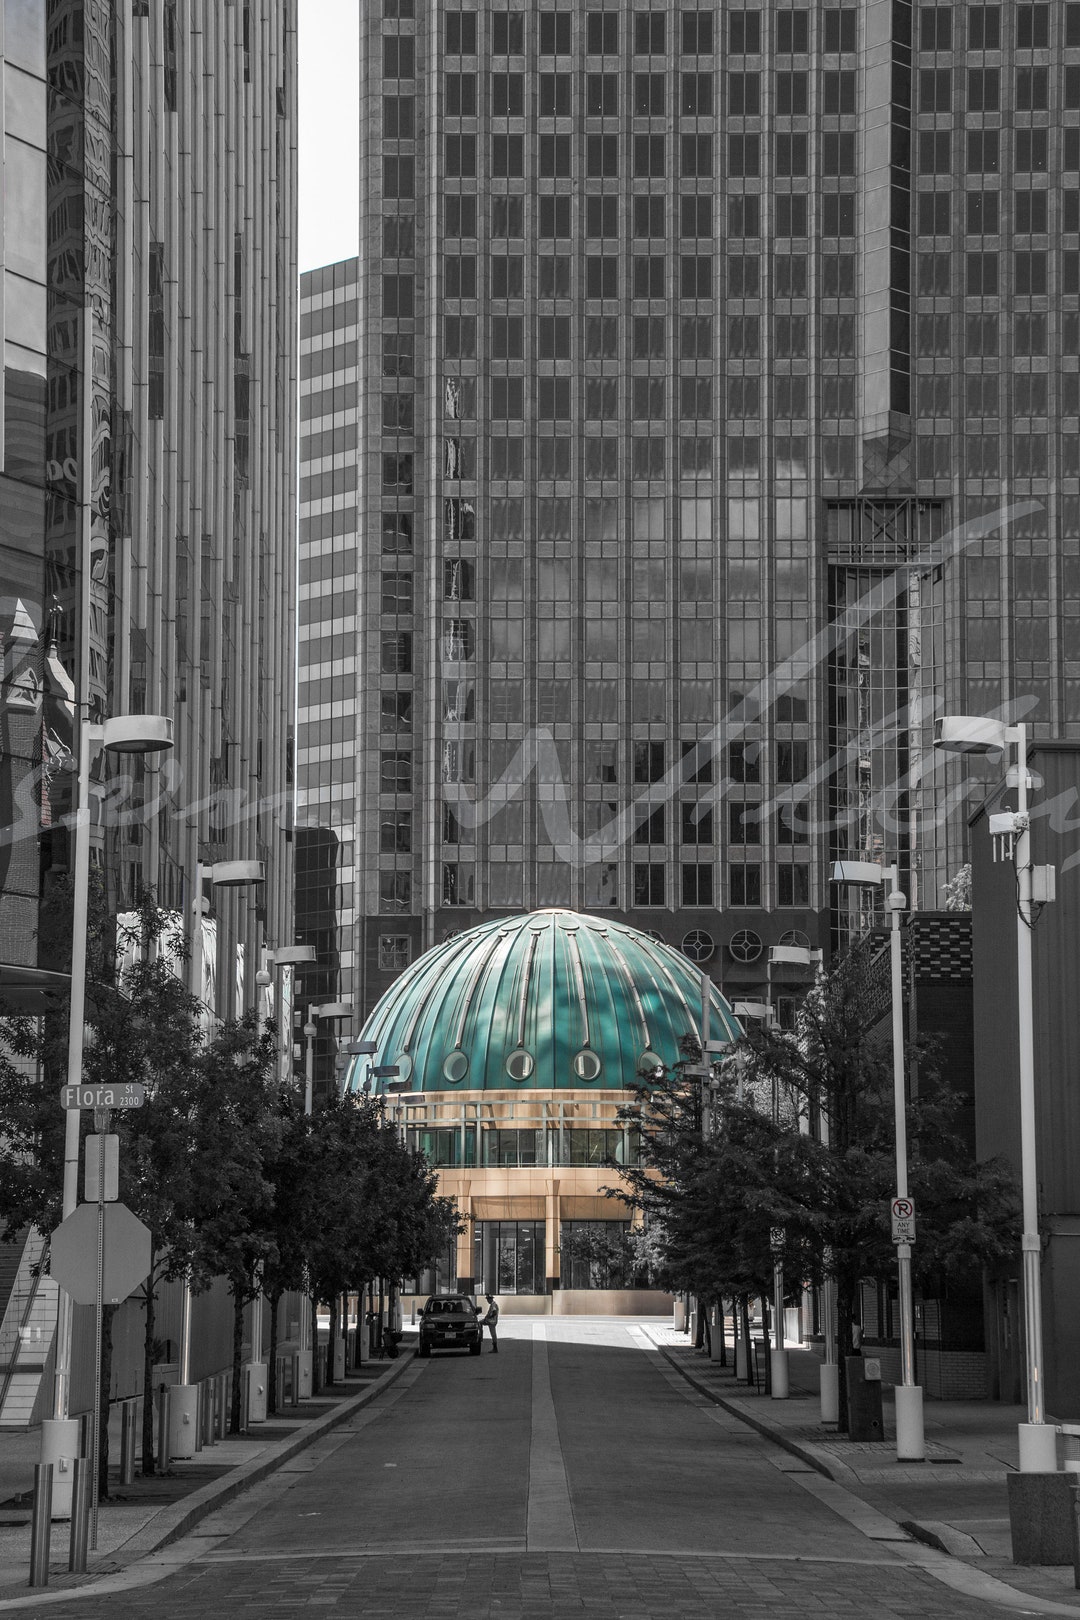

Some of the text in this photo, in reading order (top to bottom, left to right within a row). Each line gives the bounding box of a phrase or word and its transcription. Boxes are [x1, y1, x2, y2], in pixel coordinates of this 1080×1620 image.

[125, 1084, 134, 1094] St
[66, 1087, 114, 1107] Flora
[120, 1096, 139, 1106] 2300
